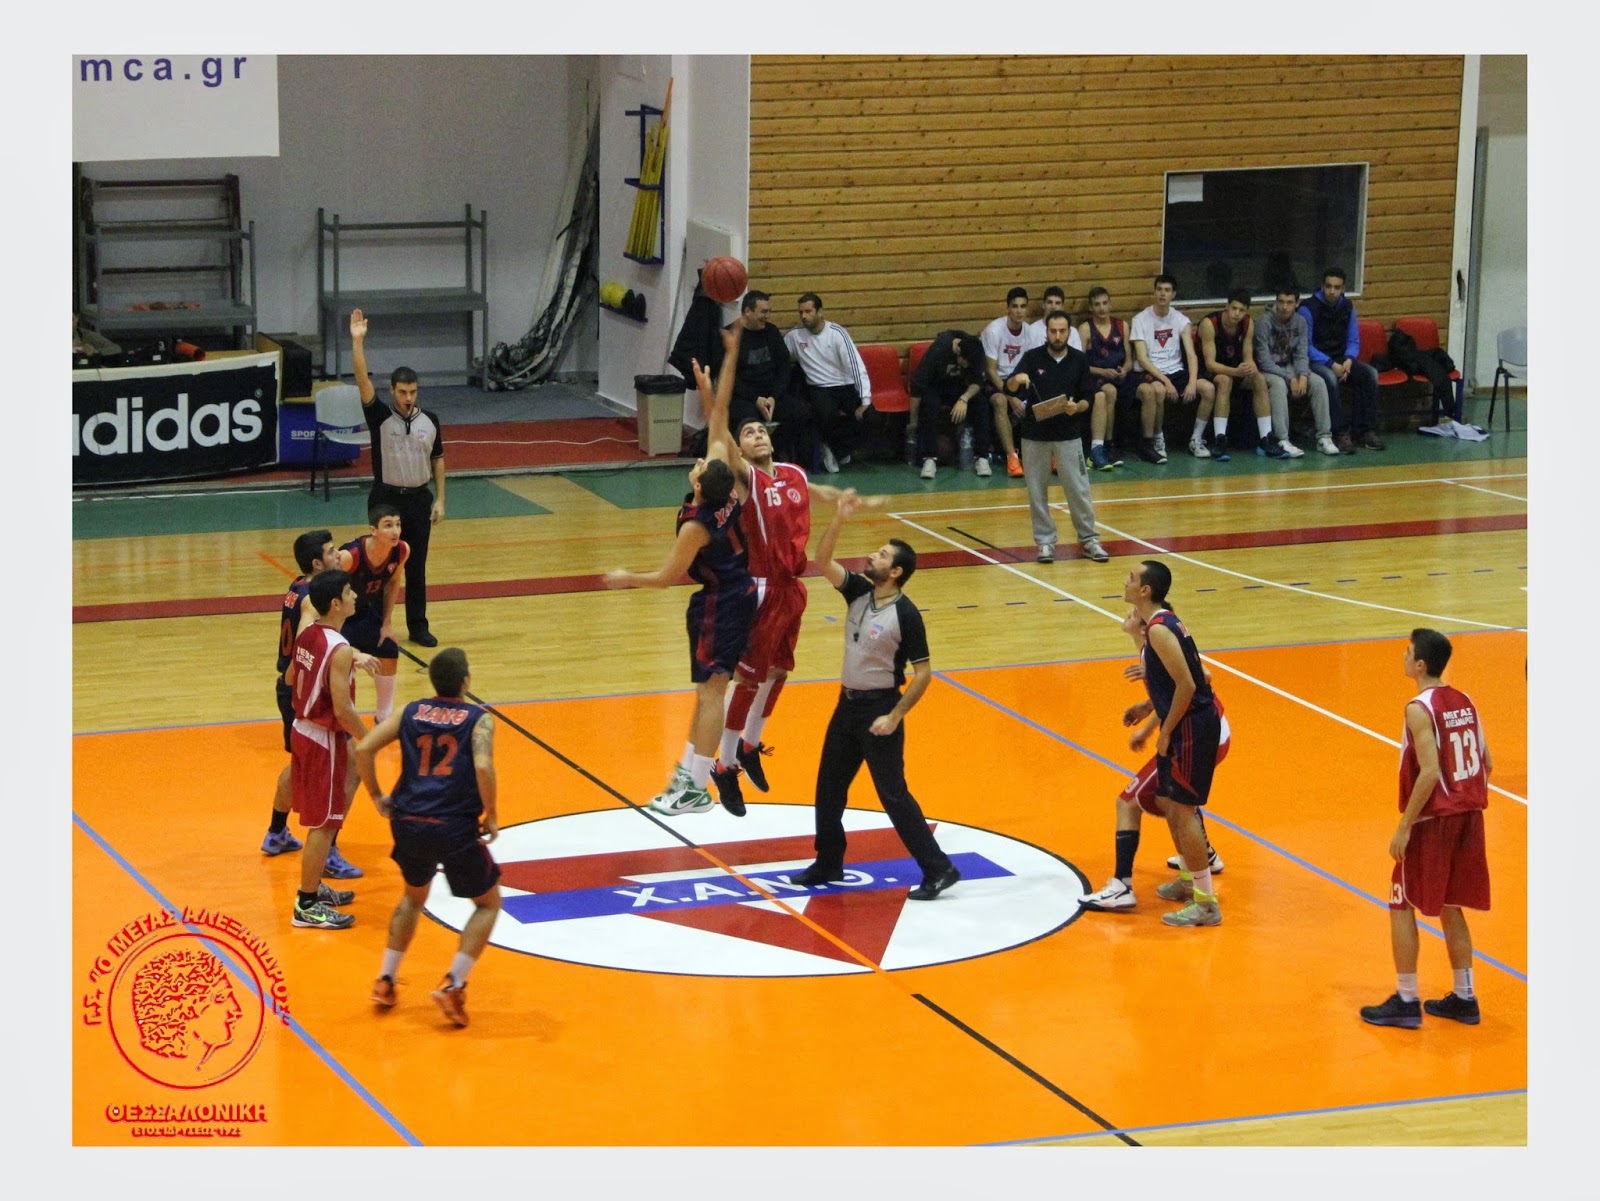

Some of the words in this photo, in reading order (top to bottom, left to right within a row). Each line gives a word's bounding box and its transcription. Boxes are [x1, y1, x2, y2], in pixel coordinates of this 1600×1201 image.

[80, 57, 247, 87] mca.gr
[72, 393, 262, 456] didas
[764, 487, 782, 507] 15
[416, 734, 458, 777] 12
[1450, 728, 1480, 781] 13
